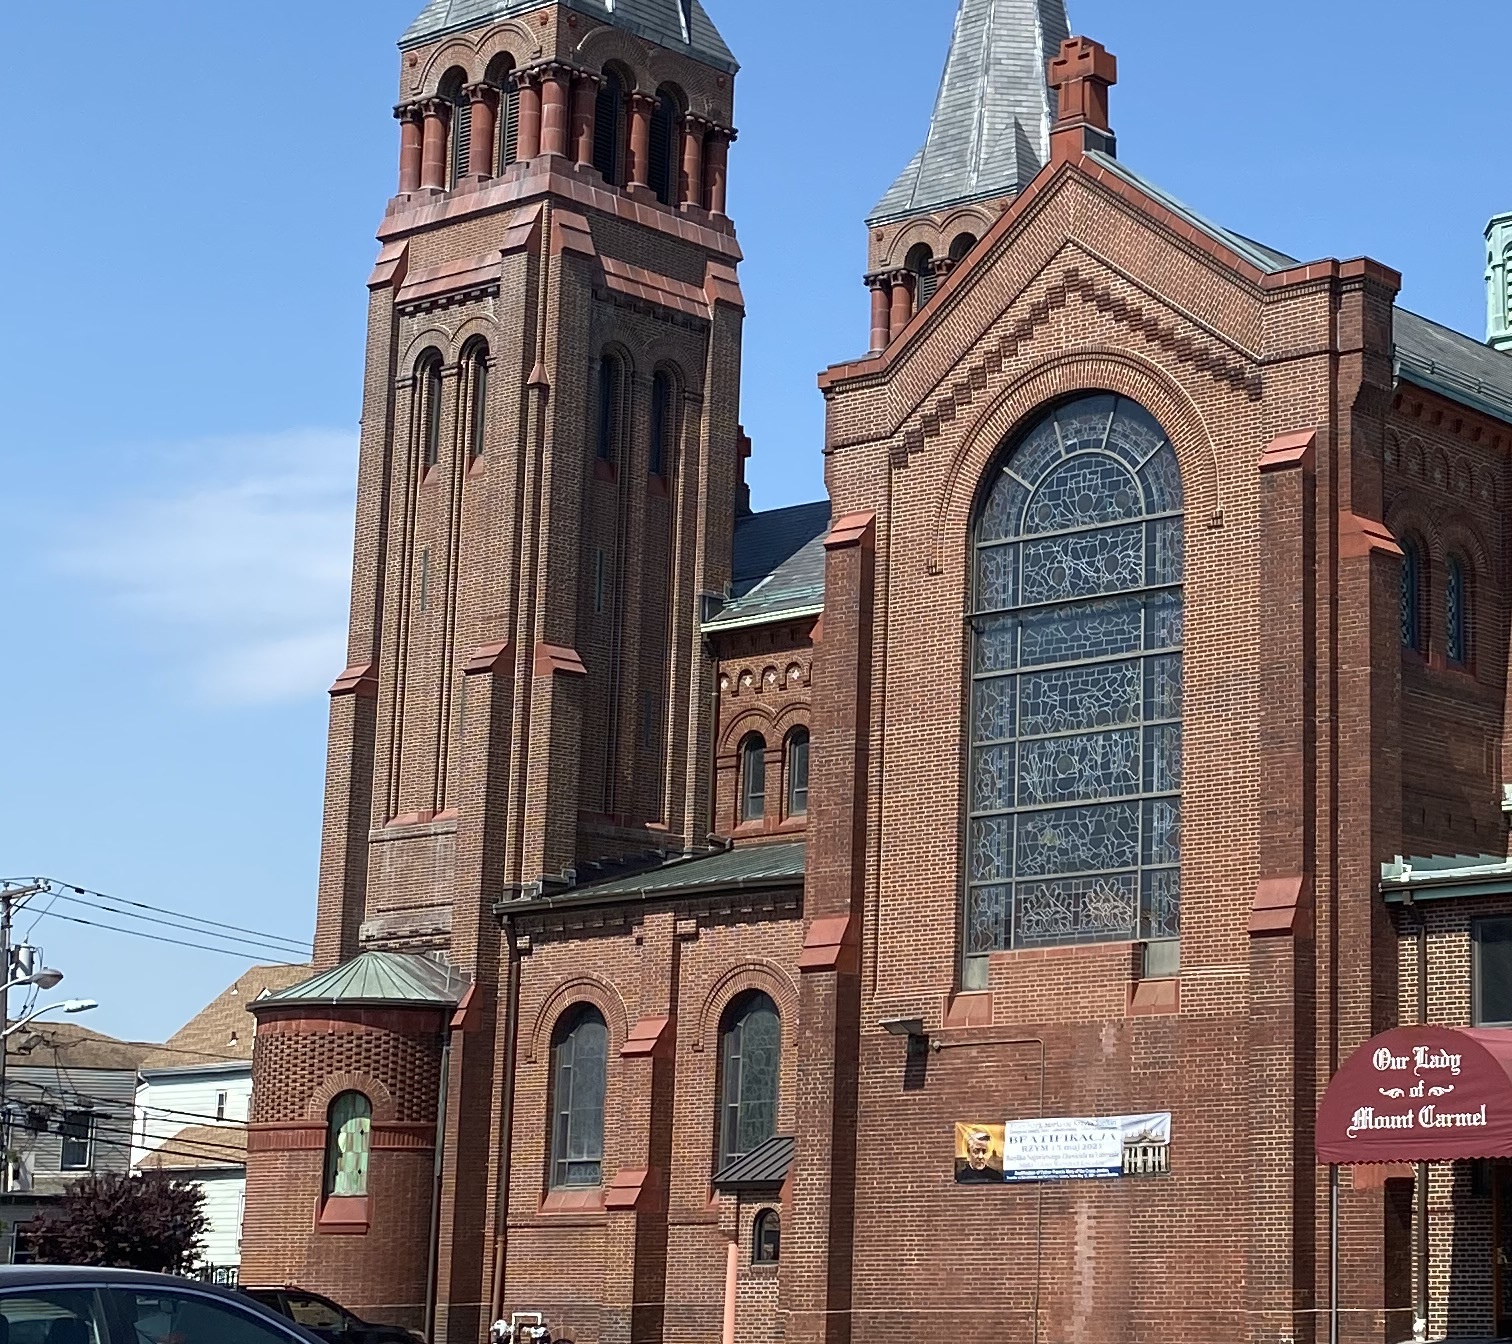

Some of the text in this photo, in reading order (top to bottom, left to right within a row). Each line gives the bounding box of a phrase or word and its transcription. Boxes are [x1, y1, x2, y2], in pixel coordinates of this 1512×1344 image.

[1372, 1045, 1462, 1076] Our Lady
[1408, 1079, 1425, 1098] of
[1346, 1104, 1487, 1138] Mount Carmel
